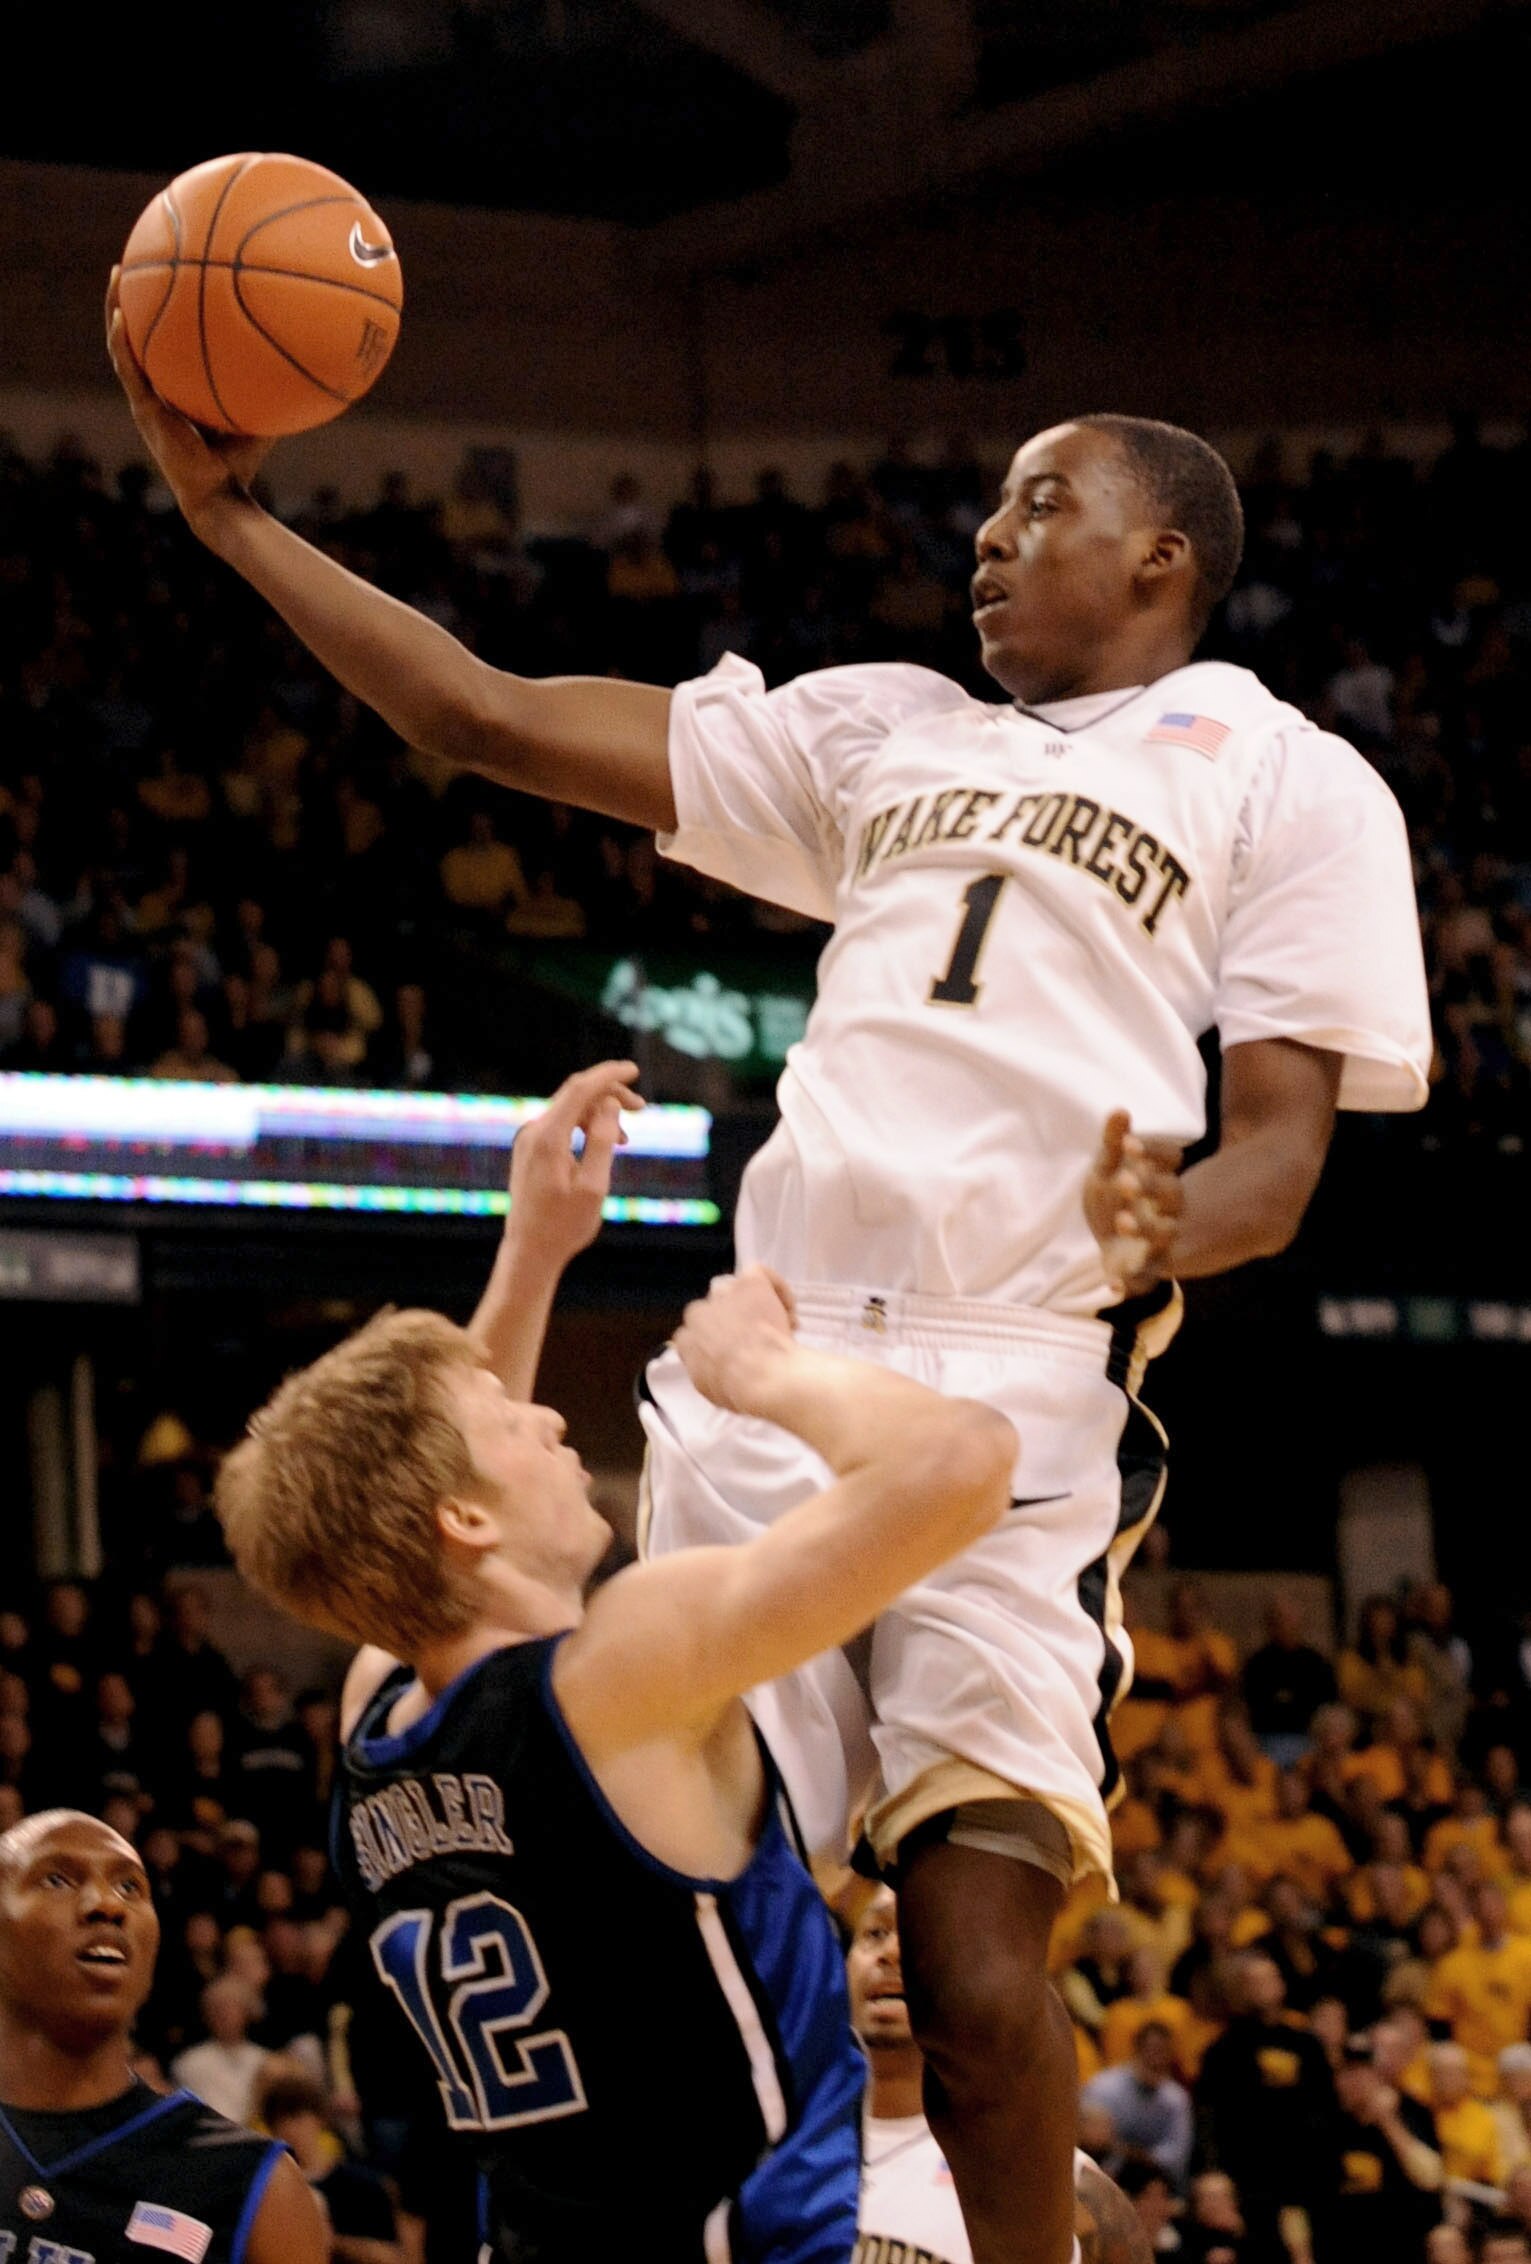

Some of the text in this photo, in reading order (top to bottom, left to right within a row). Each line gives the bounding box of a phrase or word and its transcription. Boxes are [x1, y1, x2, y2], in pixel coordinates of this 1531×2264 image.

[927, 869, 1013, 1008] 1
[988, 793, 1192, 940] FOREST
[369, 1890, 589, 2131] 12
